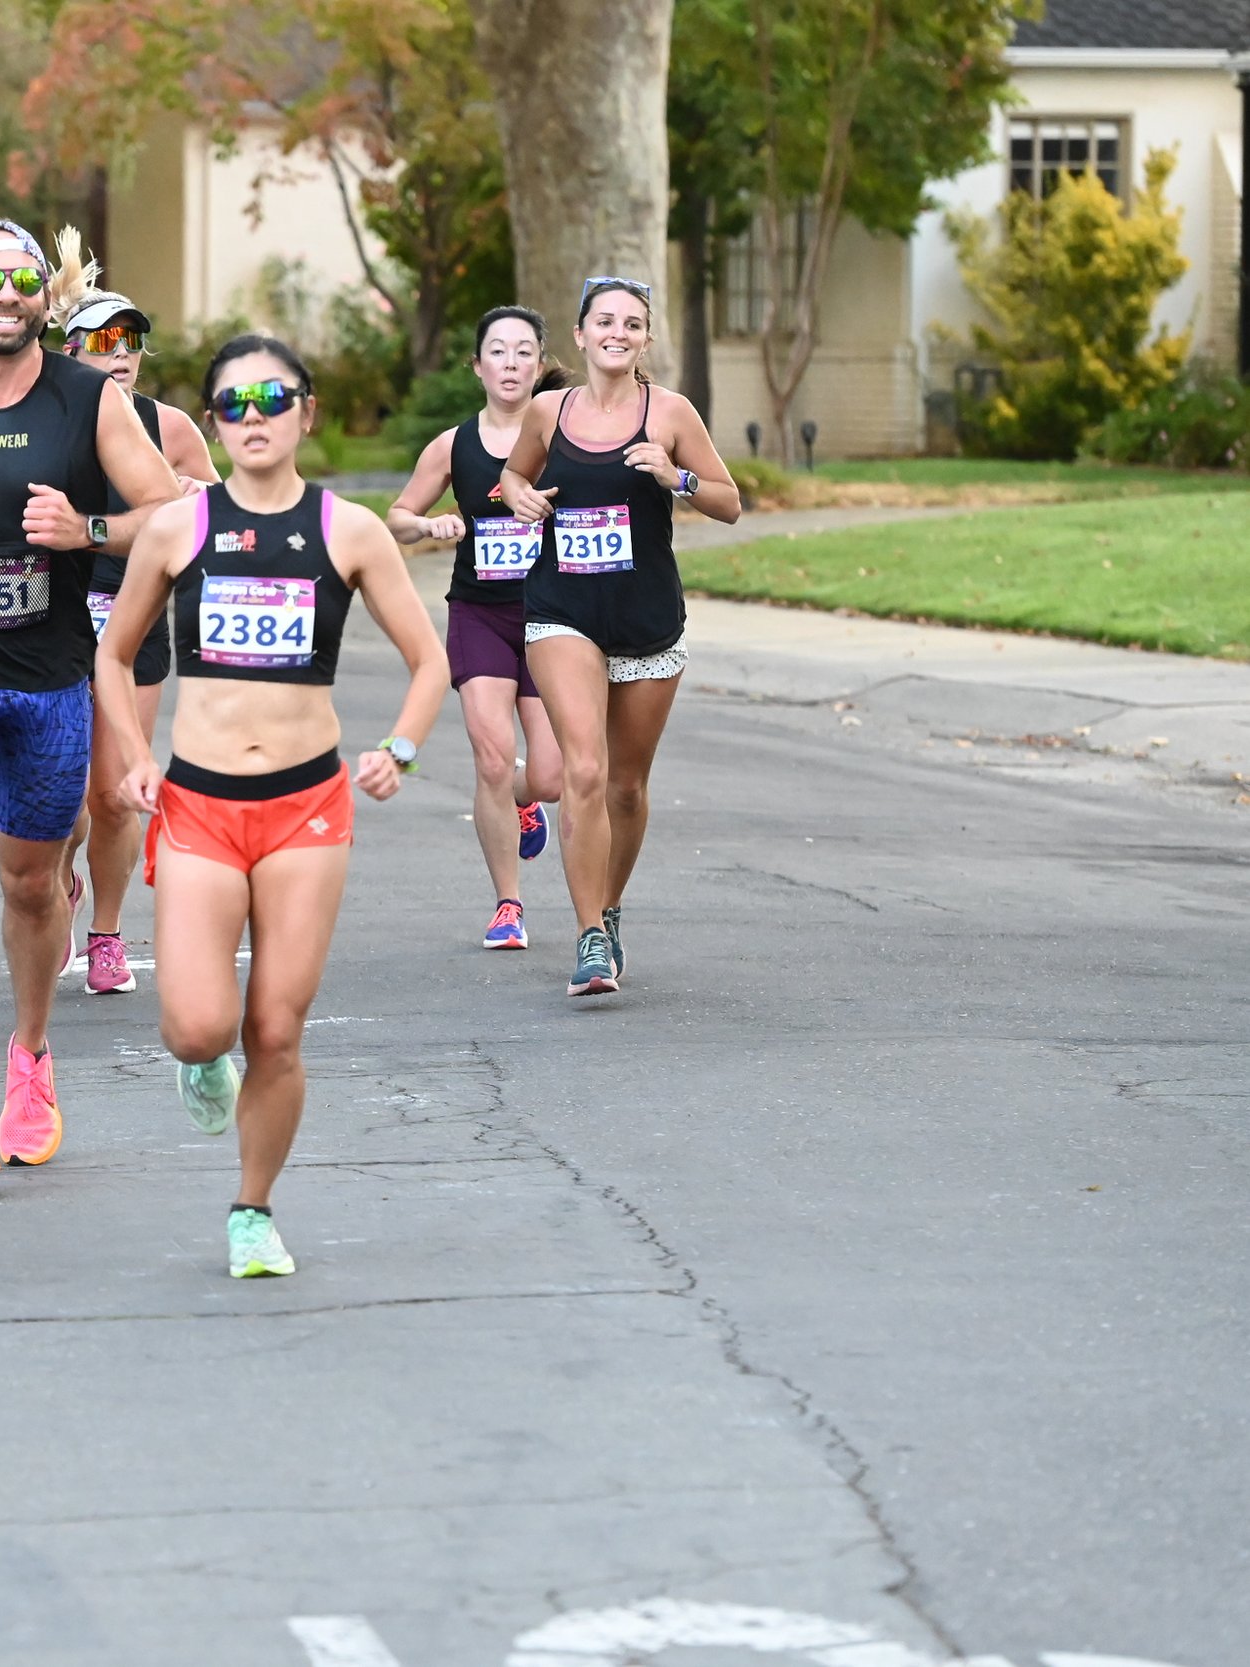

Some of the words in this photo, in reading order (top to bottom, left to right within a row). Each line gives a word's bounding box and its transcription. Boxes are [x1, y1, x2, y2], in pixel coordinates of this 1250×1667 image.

[477, 522, 503, 531] Urban
[503, 522, 523, 530] Cow
[555, 512, 581, 522] Urban
[581, 513, 601, 521] Cow
[480, 541, 540, 565] 1234
[561, 532, 623, 558] 2319
[206, 613, 307, 647] 2384
